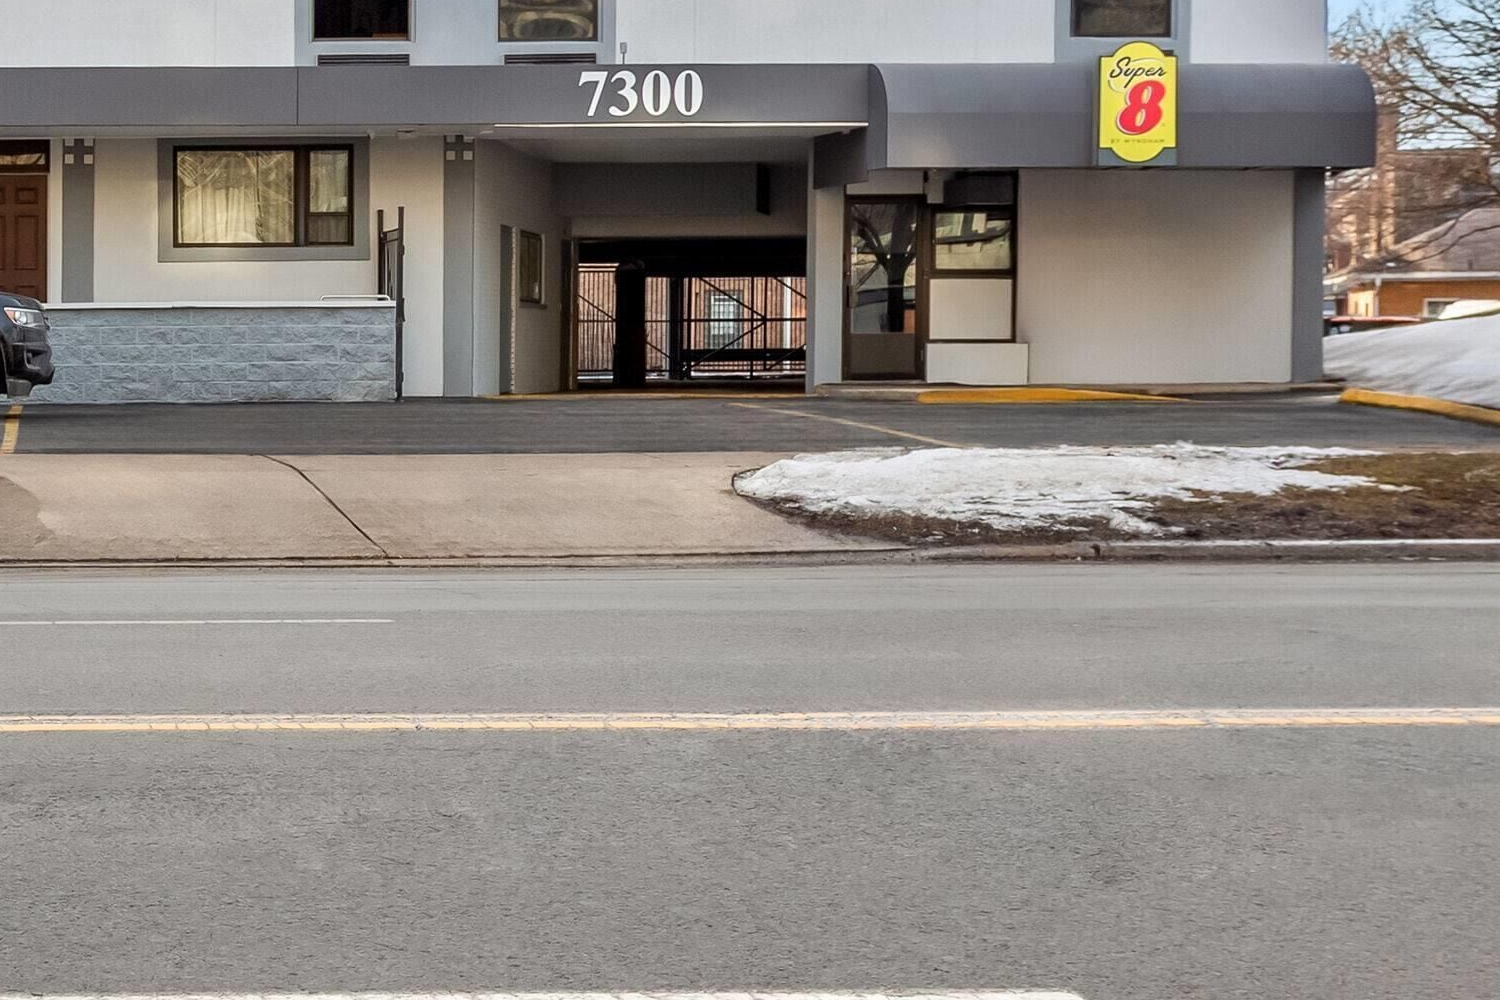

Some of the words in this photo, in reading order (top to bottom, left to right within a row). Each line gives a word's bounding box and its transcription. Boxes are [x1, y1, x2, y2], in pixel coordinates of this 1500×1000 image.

[578, 70, 703, 116] 7300
[1109, 56, 1167, 88] Super
[1116, 80, 1166, 135] 8
